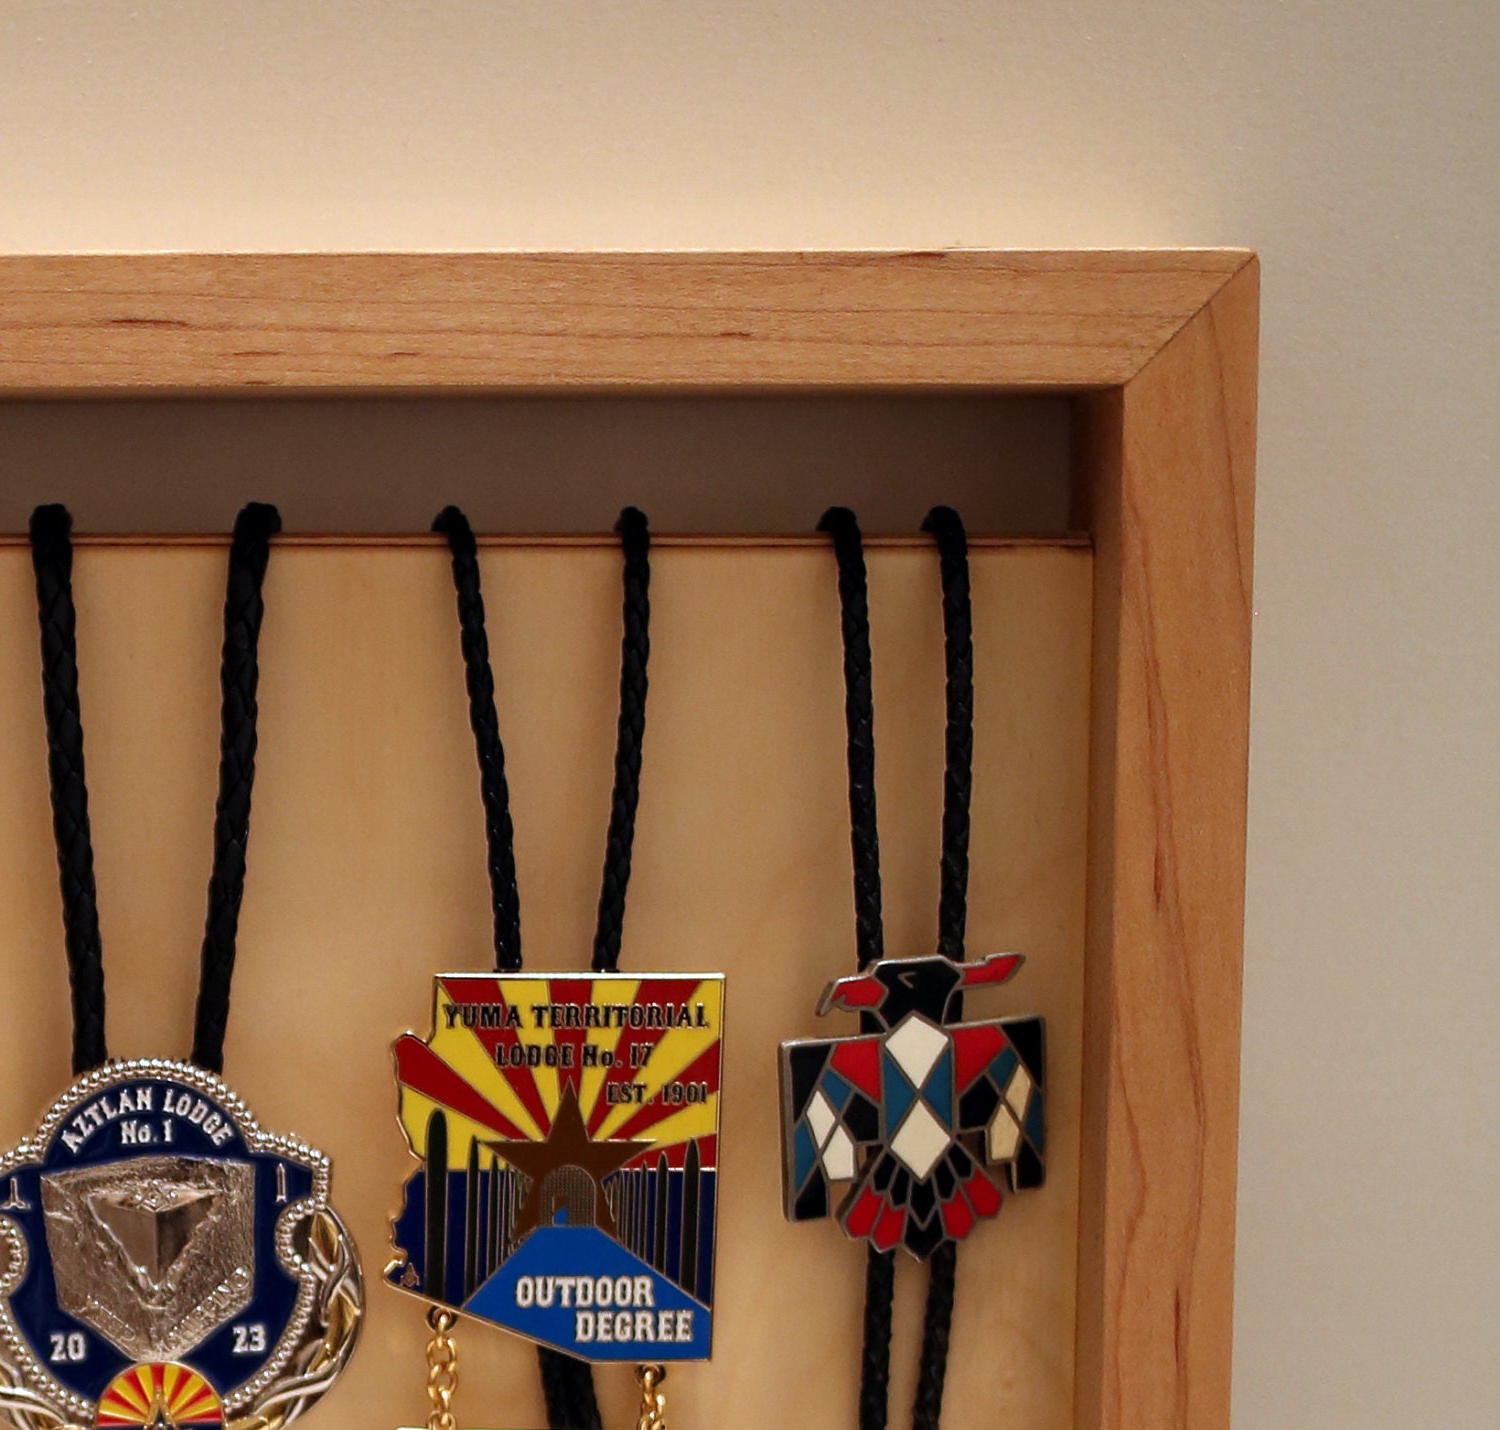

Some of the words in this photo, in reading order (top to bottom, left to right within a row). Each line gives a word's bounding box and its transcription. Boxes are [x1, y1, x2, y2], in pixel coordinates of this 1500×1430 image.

[443, 1002, 524, 1030] YUMA
[531, 1002, 710, 1030] TERRITORIAL
[495, 1042, 576, 1069] LODGE
[581, 1042, 624, 1069] No.
[629, 1042, 655, 1070] 17
[606, 1080, 655, 1105] EST.
[660, 1080, 709, 1105] 1901
[61, 1086, 153, 1154] AZTLAN
[162, 1088, 234, 1147] LODGE
[120, 1119, 159, 1145] No.
[162, 1119, 173, 1142] 1
[514, 1275, 656, 1309] OUTDOOR
[231, 1323, 267, 1353] 23
[574, 1309, 695, 1344] DEGREE
[50, 1332, 86, 1361] 20
